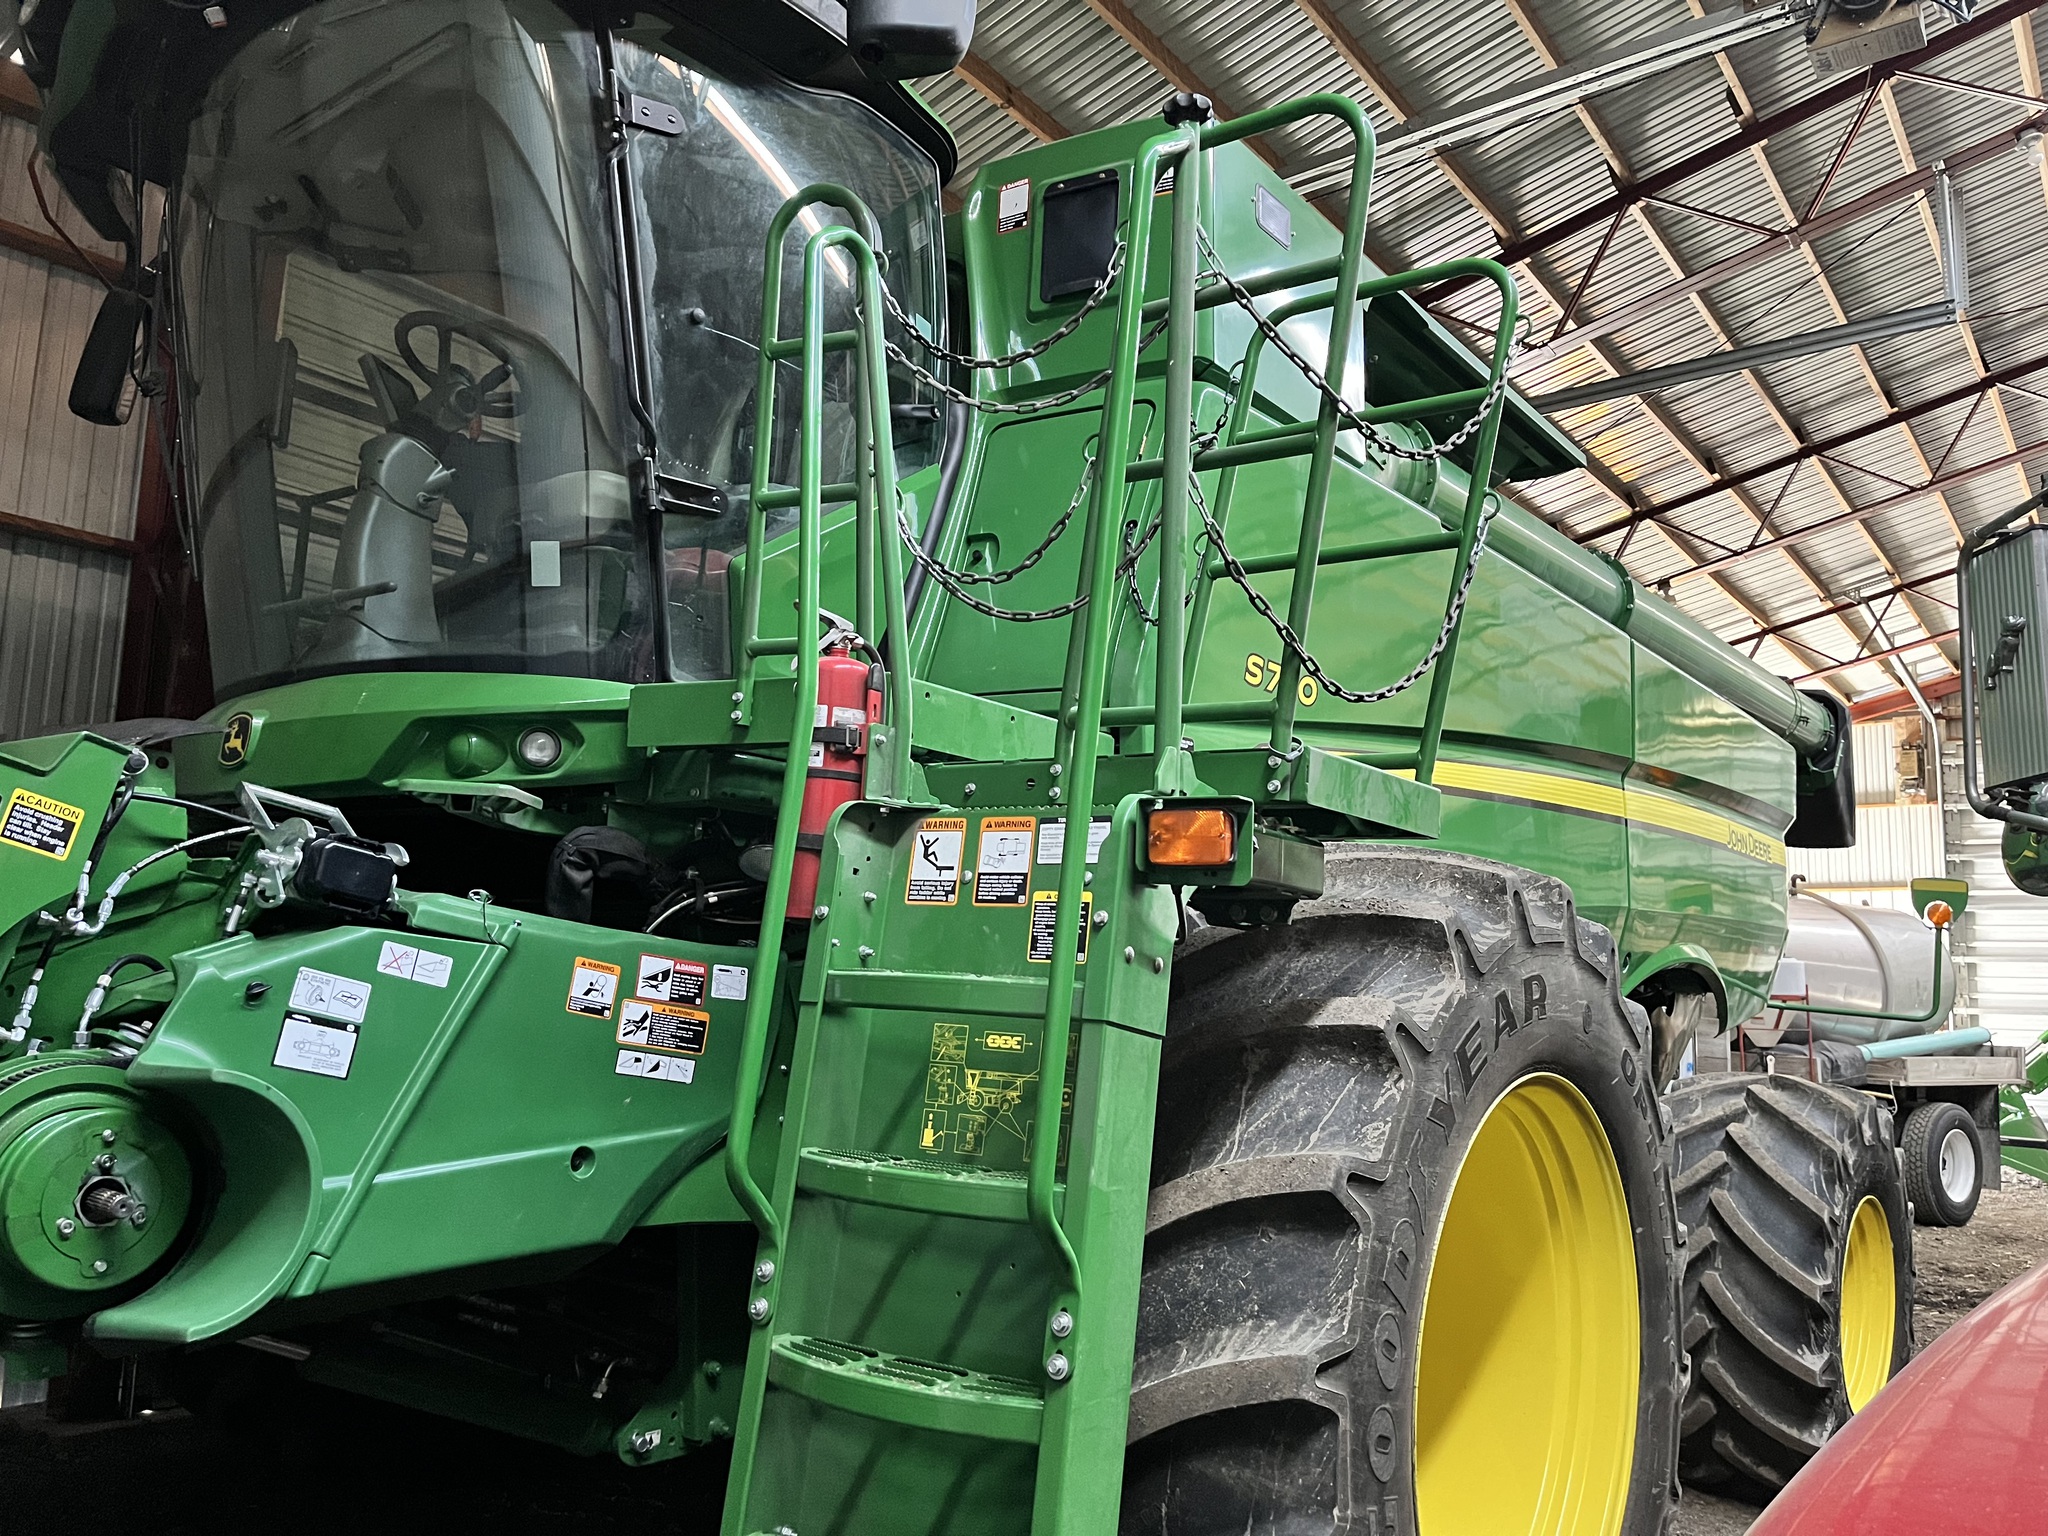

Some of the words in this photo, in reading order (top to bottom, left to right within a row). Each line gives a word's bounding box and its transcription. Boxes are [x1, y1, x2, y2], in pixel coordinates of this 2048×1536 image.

[1244, 652, 1319, 707] S70
[14, 804, 35, 816] Avoid
[34, 811, 64, 826] crushing
[26, 795, 80, 820] CAUTION
[9, 817, 22, 826] can
[35, 825, 52, 836] Stay
[40, 819, 65, 833] Header
[925, 820, 964, 830] WARNING
[994, 820, 1032, 829] WARNING
[6, 823, 25, 834] clear
[24, 828, 42, 840] when
[42, 836, 65, 847] engine
[1726, 824, 1748, 851] JOHN
[1748, 832, 1772, 861] DEERE
[587, 961, 615, 973] WARNING
[668, 1007, 695, 1017] WARNING
